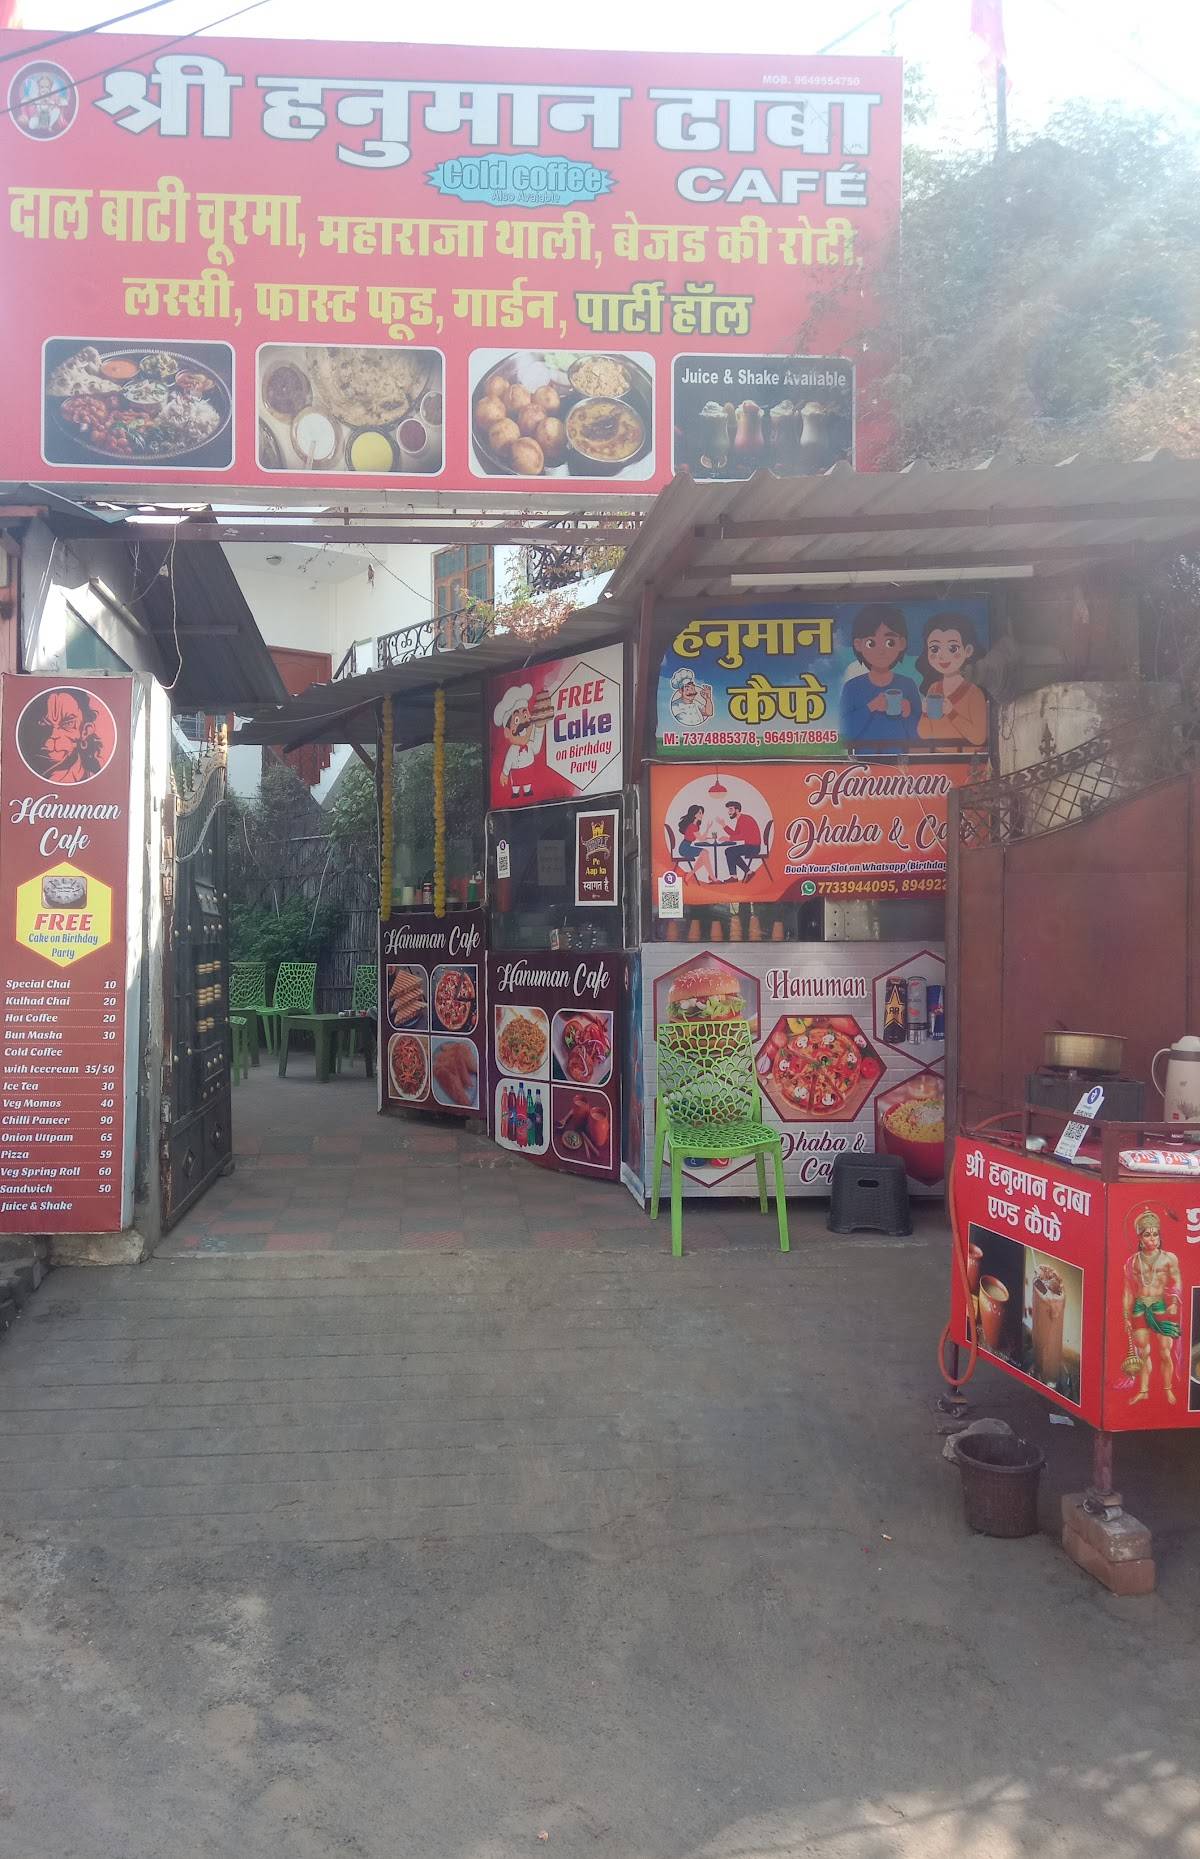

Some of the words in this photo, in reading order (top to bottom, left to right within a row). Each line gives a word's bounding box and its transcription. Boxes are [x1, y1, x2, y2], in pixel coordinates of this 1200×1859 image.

[92, 54, 243, 138] श्री
[256, 76, 633, 168] हनुमान
[648, 87, 881, 156] ढाबा
[443, 160, 507, 190] Cold
[513, 162, 602, 192] coffee
[676, 163, 868, 205] CAFÉ
[8, 187, 93, 240] दाल
[100, 175, 190, 243] बाटी
[196, 193, 306, 266] चूरमा,
[318, 216, 488, 257] महाराजा
[496, 211, 602, 269] थाली,
[612, 211, 709, 263] बेजड
[716, 215, 772, 265] की
[122, 268, 242, 327] लस्सी,
[254, 283, 359, 323] फास्ट
[366, 286, 443, 341] फूड,
[452, 277, 567, 338] गार्डन,
[575, 281, 665, 334] पार्टी
[670, 282, 753, 335] हॉल
[682, 368, 718, 385] Juice
[723, 369, 733, 384] &
[738, 369, 779, 385] Shake
[783, 370, 847, 387] Available
[673, 617, 834, 669] हनुमान
[557, 679, 606, 710] FREE
[727, 673, 827, 725] कैफे
[553, 708, 612, 743] Cake
[663, 732, 679, 745] M:
[683, 731, 760, 746] 7374885378,
[764, 730, 838, 745] 9649178845
[556, 750, 567, 761] on
[569, 741, 612, 759] Birthday
[570, 760, 597, 774] Party
[805, 764, 950, 806] Hanuman
[9, 794, 121, 825] Hanuman
[39, 825, 91, 858] Cafe
[785, 814, 881, 860] Dhaba
[888, 817, 909, 850] &
[585, 866, 598, 876] Aap
[785, 865, 807, 875] Book
[809, 863, 830, 874] Your
[831, 862, 847, 873] Slot
[849, 864, 860, 872] on
[862, 860, 906, 874] Whatsapp
[582, 880, 602, 892] स्वागत
[817, 880, 899, 894] 7733944095,
[34, 914, 93, 931] FREE
[28, 932, 48, 943] Cake
[50, 935, 60, 943] on
[62, 932, 98, 945] Birthday
[384, 925, 446, 955] Hanuman
[448, 923, 480, 956] Cafe
[51, 948, 75, 960] Party
[6, 980, 44, 990] Special
[46, 980, 71, 989] Chai
[104, 981, 116, 989] 10
[496, 959, 571, 993] Hanuman
[573, 961, 611, 998] Cafe
[766, 968, 866, 999] Hanuman
[5, 997, 44, 1006] Kulhad
[46, 997, 71, 1006] Chai
[103, 998, 116, 1006] 20
[5, 1014, 22, 1023] Hot
[25, 1014, 58, 1023] Coffee
[103, 1015, 116, 1023] 20
[5, 1031, 25, 1040] Bun
[28, 1031, 63, 1040] Maska
[103, 1032, 115, 1040] 30
[4, 1048, 28, 1057] Cold
[30, 1048, 63, 1057] Coffee
[4, 1064, 28, 1074] with
[30, 1065, 79, 1074] Icecream
[3, 1082, 19, 1091] Ice
[21, 1082, 39, 1091] Tea
[102, 1083, 114, 1091] 30
[3, 1099, 21, 1109] Veg
[23, 1099, 62, 1108] Momos
[101, 1099, 114, 1108] 40
[2, 1116, 30, 1125] Chilli
[100, 1116, 113, 1125] 90
[2, 1133, 33, 1142] Onion
[100, 1133, 113, 1142] 65
[779, 1131, 847, 1161] Dhaba
[1, 1150, 29, 1159] Pizza
[100, 1150, 112, 1159] 59
[1, 1167, 19, 1178] Veg
[21, 1167, 57, 1178] Spring
[59, 1167, 81, 1176] Roll
[99, 1167, 112, 1176] 60
[801, 1157, 833, 1184] Ca
[965, 1150, 985, 1179] श्री
[989, 1161, 1048, 1200] हनुमान
[0, 1184, 53, 1193] Sandwich
[99, 1184, 111, 1193] 50
[1, 1201, 28, 1213] Juice
[30, 1202, 38, 1210] &
[40, 1201, 73, 1210] Shake
[988, 1195, 1020, 1226] एण्ड
[1024, 1204, 1062, 1241] कैफे
